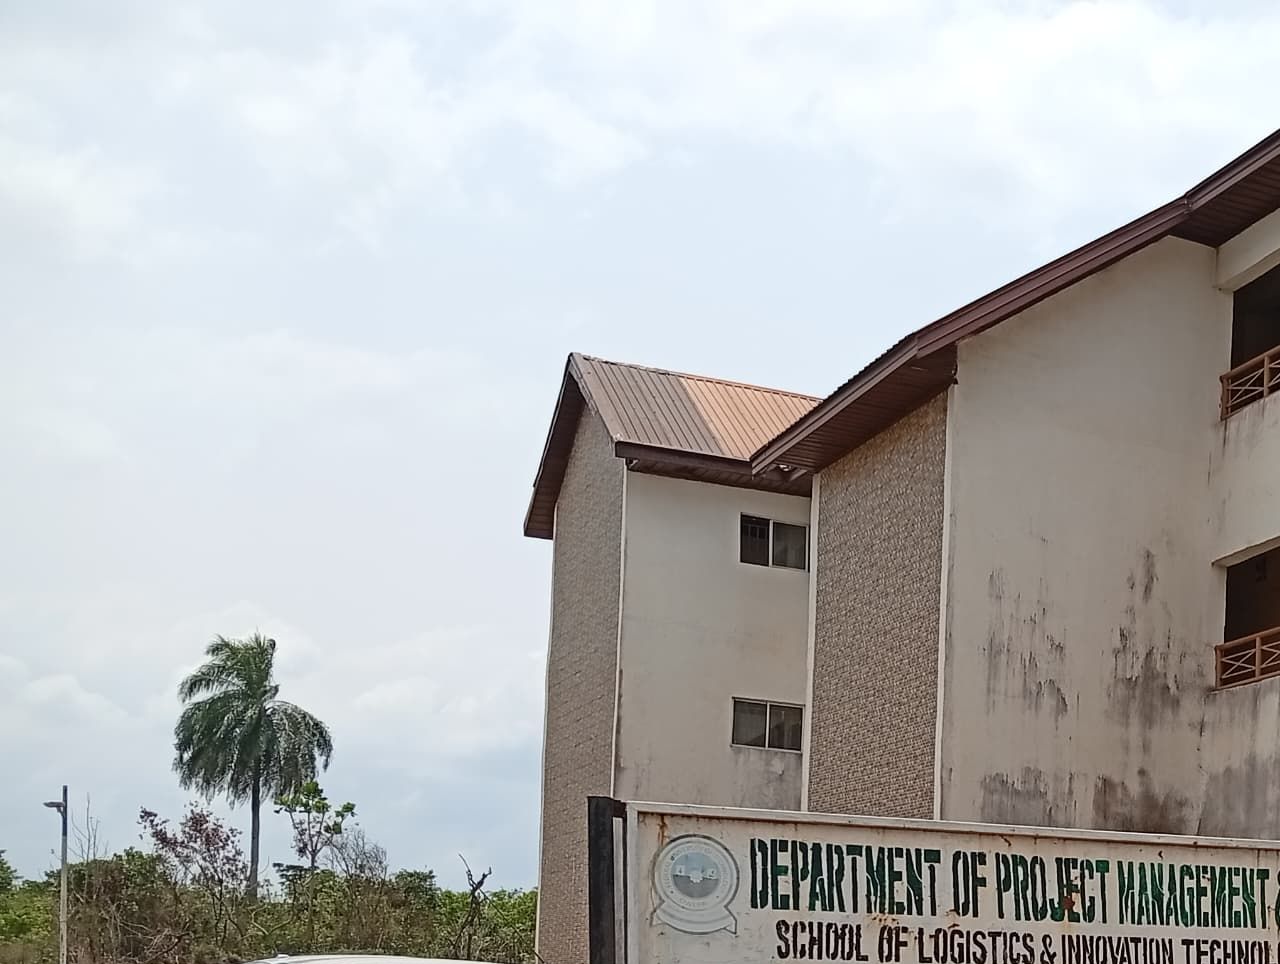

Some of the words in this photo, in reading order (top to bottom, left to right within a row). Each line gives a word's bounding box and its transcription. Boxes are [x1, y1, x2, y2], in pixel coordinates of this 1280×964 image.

[750, 838, 941, 916] DEPARTMENT
[952, 850, 987, 918] OF
[995, 851, 1110, 922] PROJECT
[1117, 860, 1270, 930] MANAGEMENT
[776, 919, 869, 962] SCHOOL
[878, 924, 910, 963] OF
